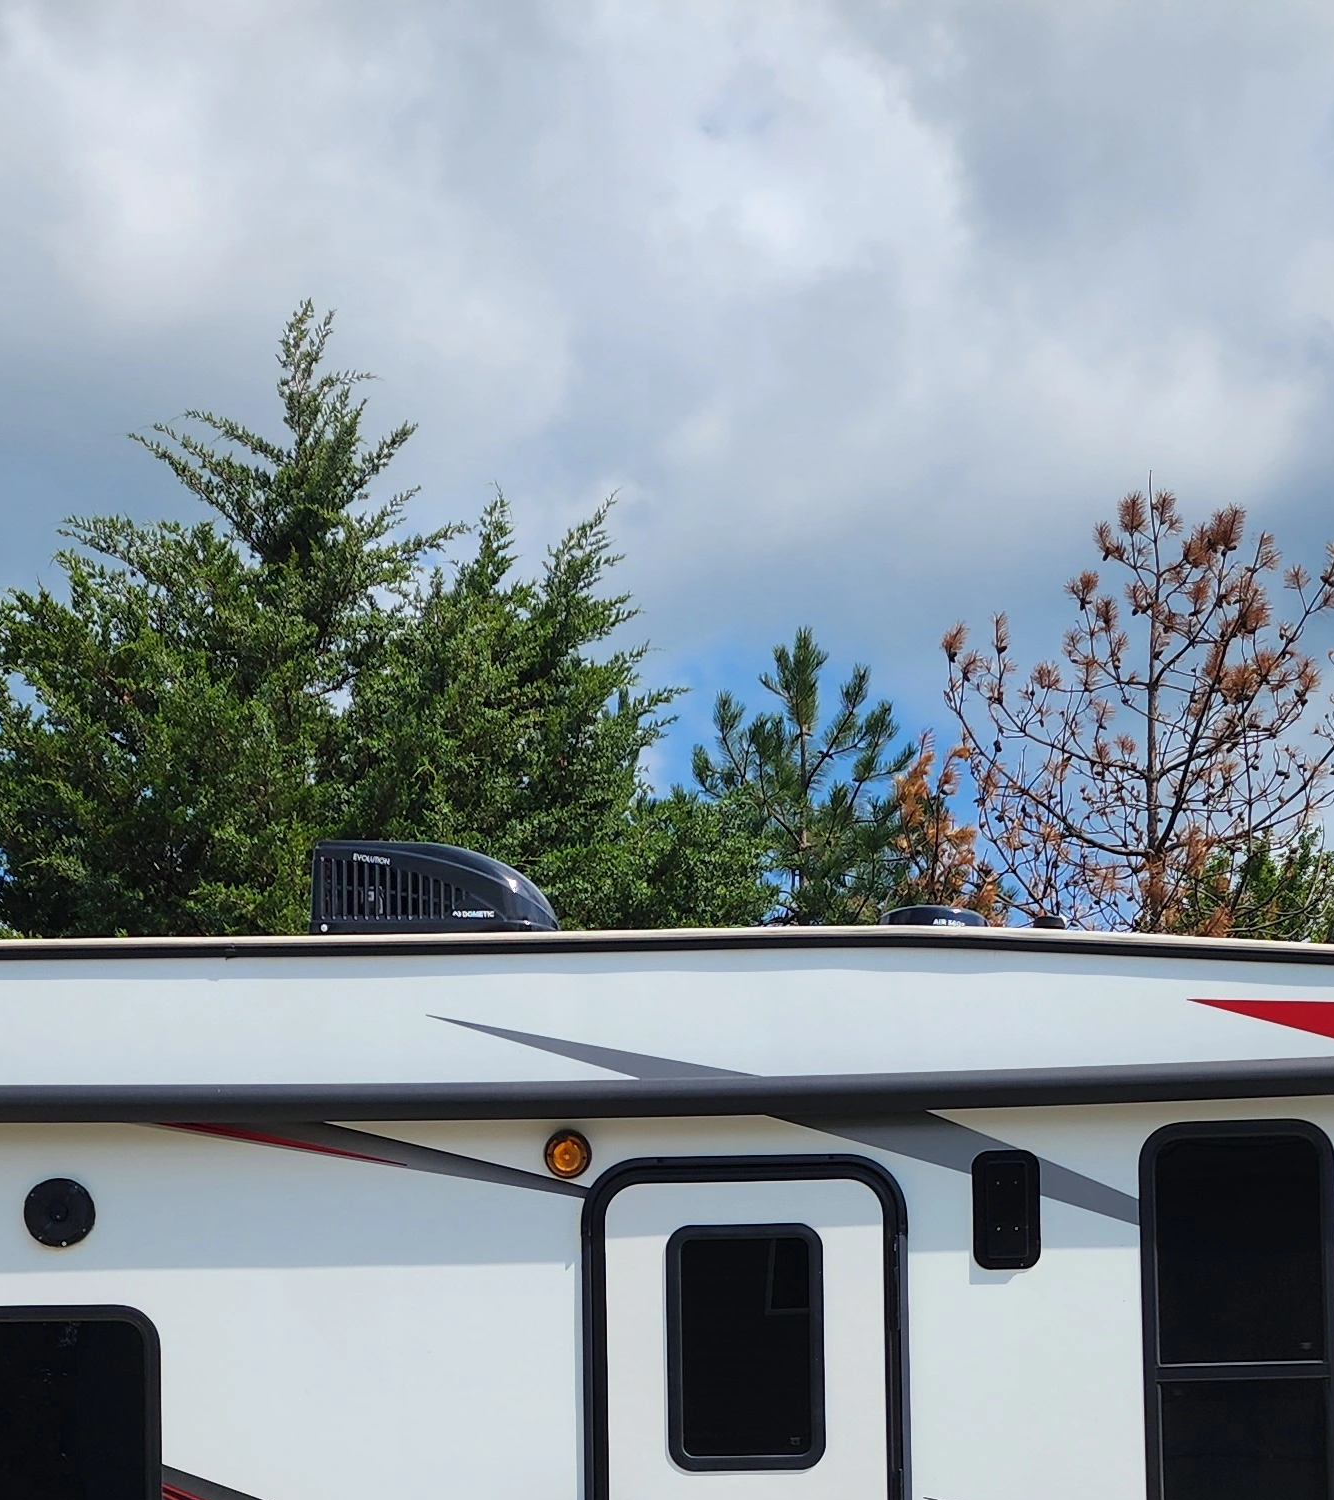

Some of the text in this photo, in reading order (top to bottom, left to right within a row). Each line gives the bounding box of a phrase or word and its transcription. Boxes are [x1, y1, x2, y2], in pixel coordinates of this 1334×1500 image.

[353, 853, 390, 866] EVOLUTION
[462, 910, 495, 918] DOMETIC
[932, 918, 947, 926] AIR
